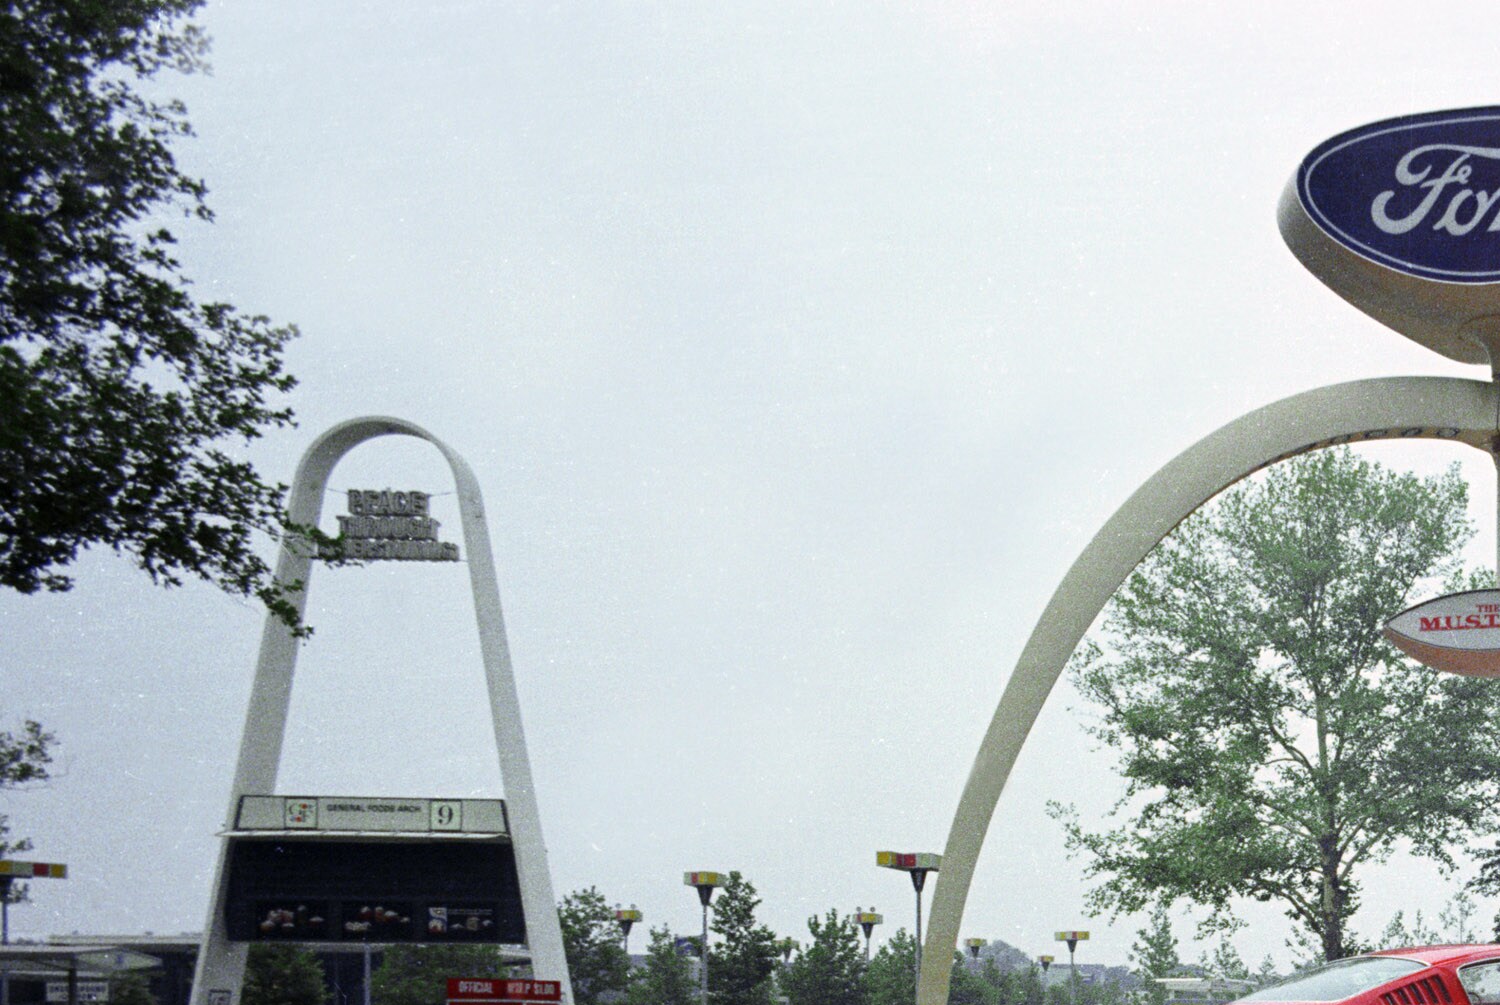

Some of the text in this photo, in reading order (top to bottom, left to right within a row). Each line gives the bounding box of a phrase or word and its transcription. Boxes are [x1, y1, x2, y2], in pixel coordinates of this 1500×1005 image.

[347, 489, 429, 516] PEACE
[1475, 604, 1500, 613] THE
[326, 803, 365, 813] GENERAL
[438, 805, 454, 825] 9
